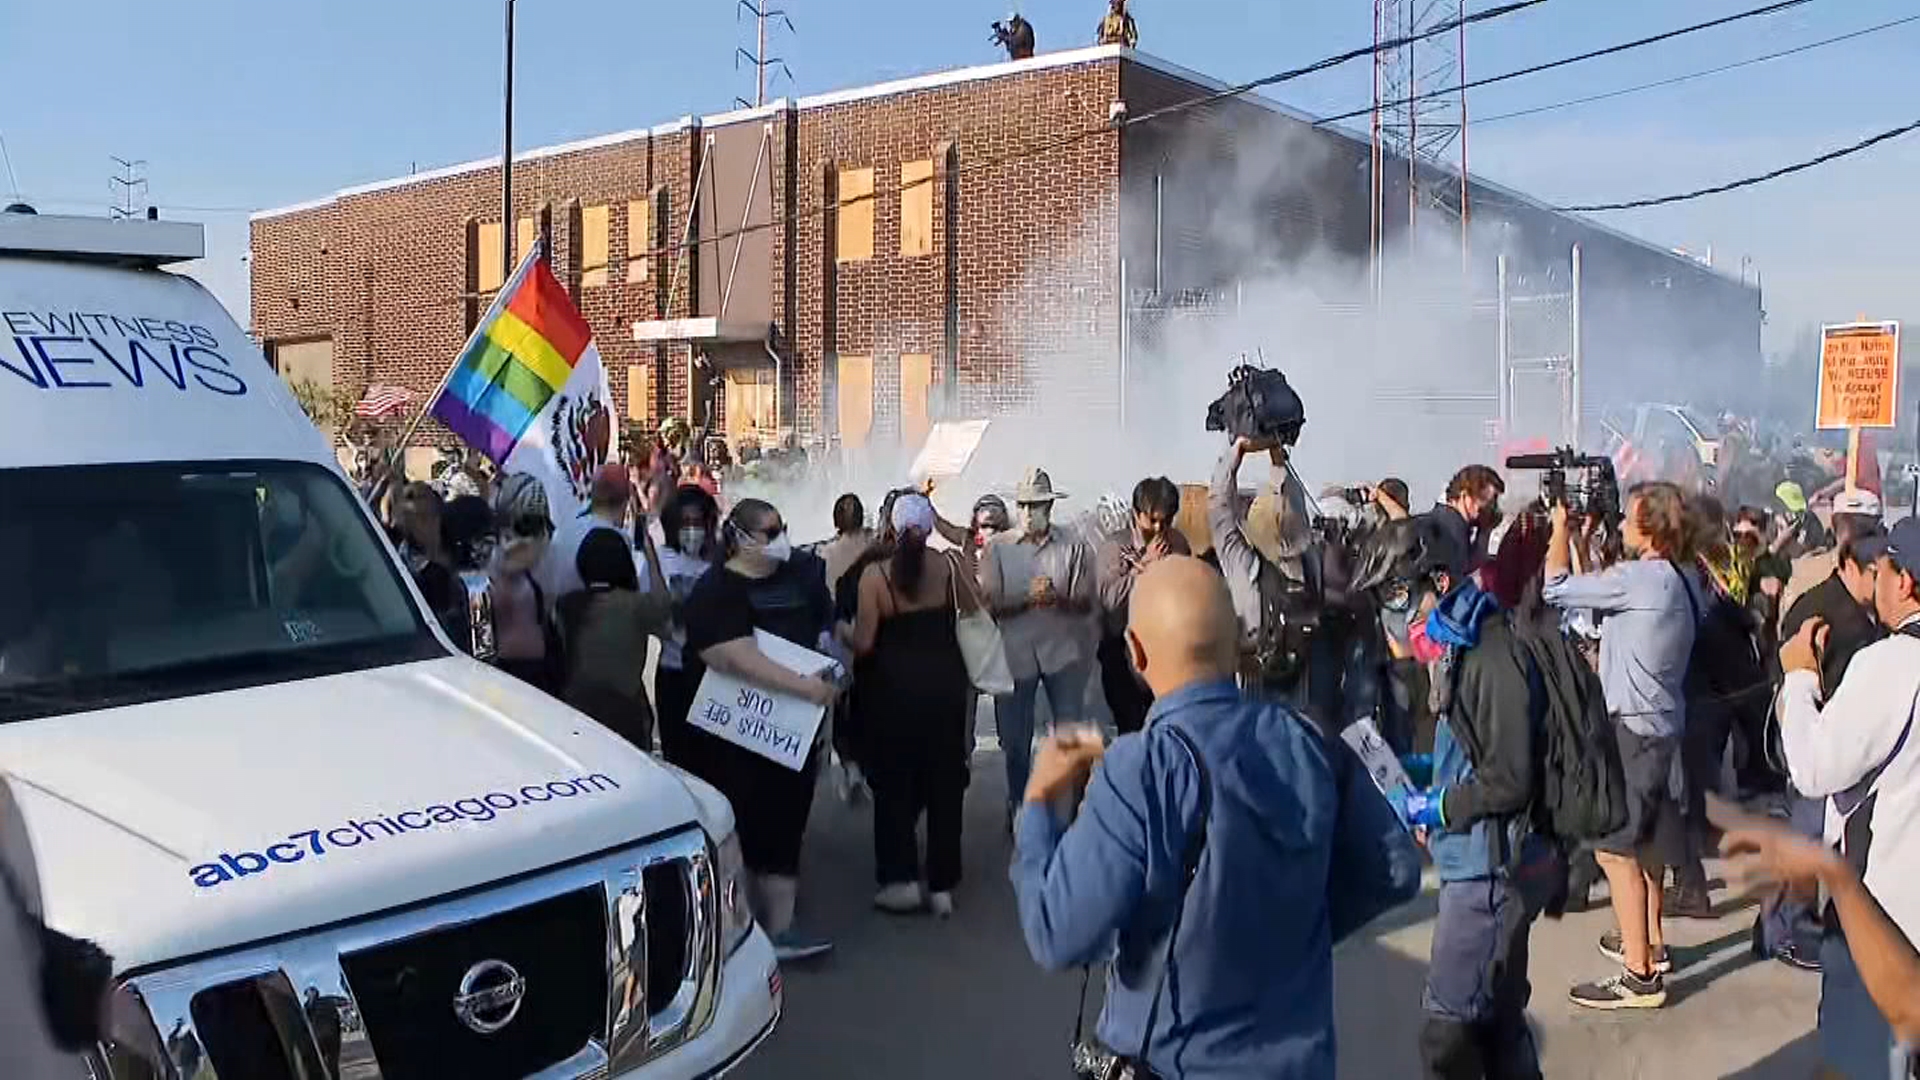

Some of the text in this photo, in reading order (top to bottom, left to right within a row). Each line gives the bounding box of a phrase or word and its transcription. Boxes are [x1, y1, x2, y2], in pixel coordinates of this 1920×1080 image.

[0, 335, 248, 396] NEWS
[704, 701, 801, 757] HANDS OFF
[738, 688, 773, 716] OUR
[188, 768, 621, 889] abc7chicago.com
